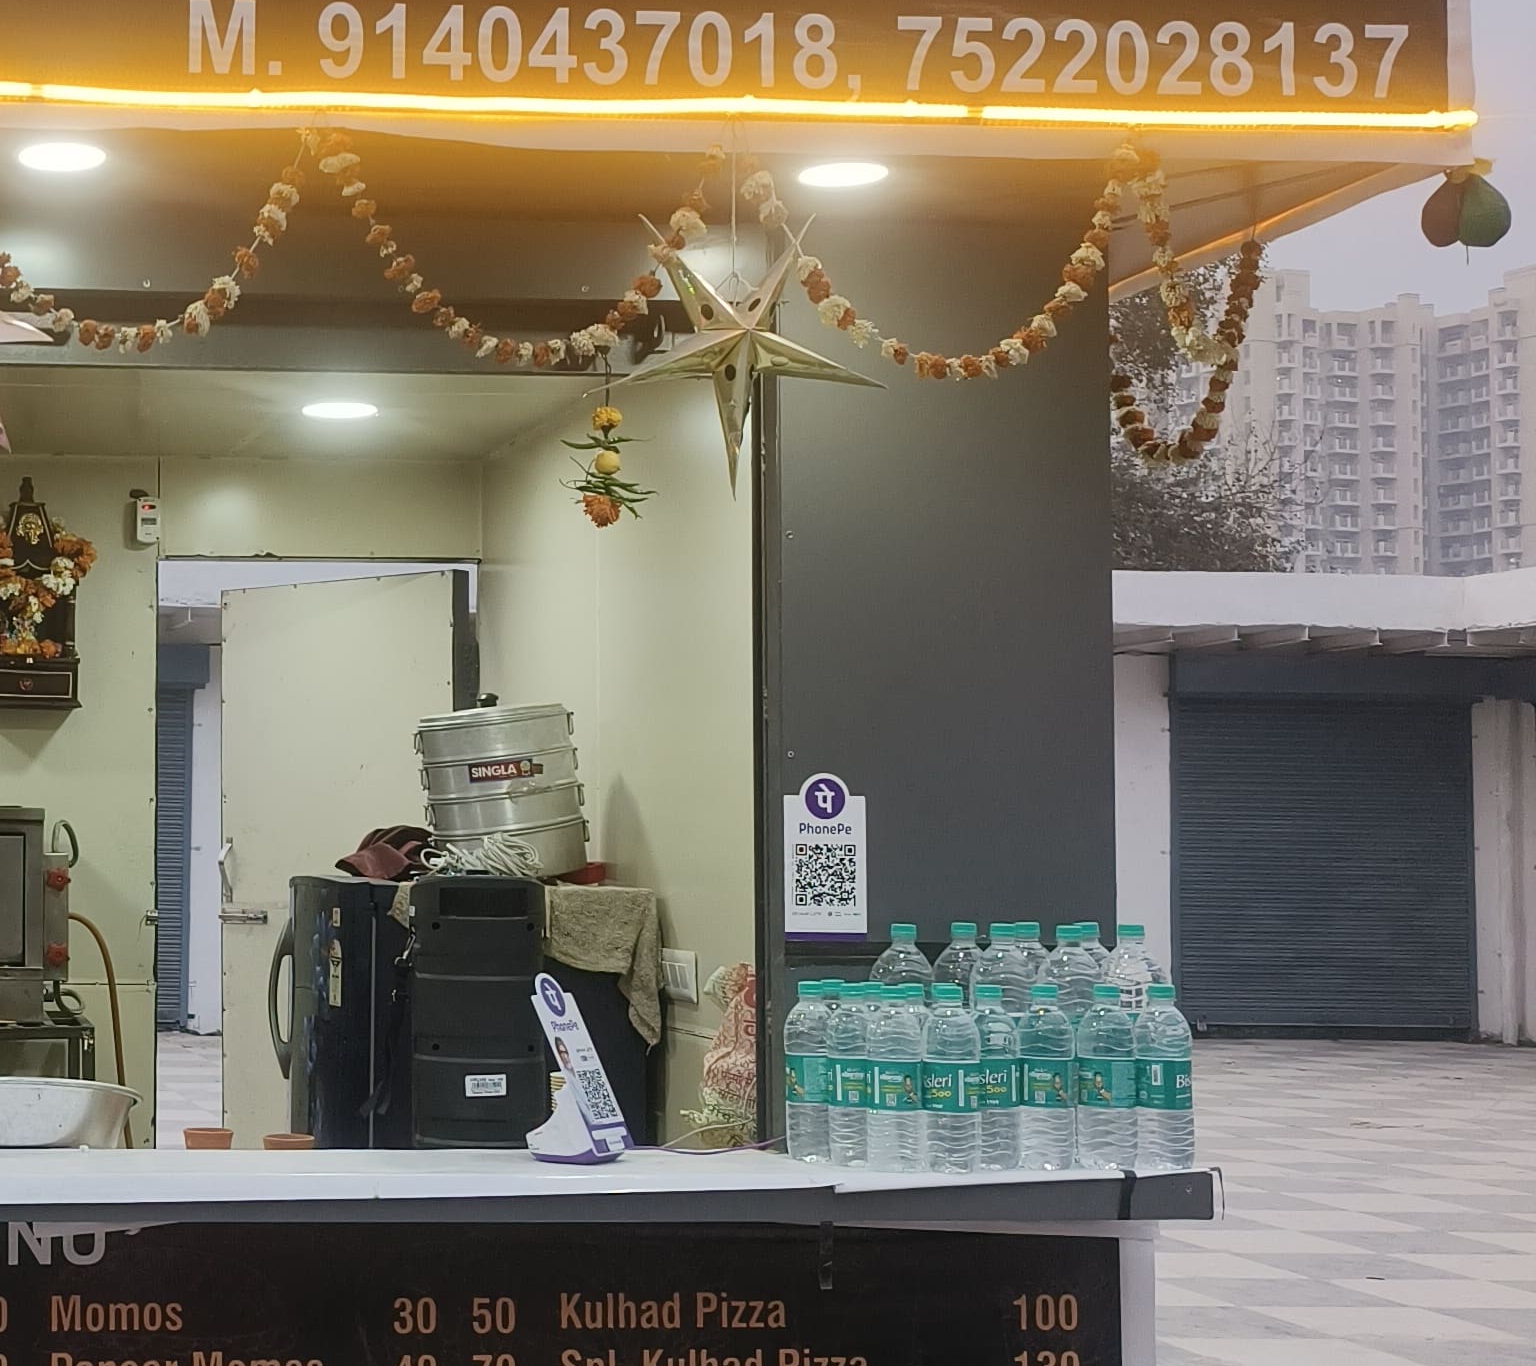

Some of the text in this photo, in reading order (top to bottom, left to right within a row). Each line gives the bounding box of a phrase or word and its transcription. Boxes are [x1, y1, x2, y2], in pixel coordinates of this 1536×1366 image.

[317, 1, 862, 100] 9140437018,
[897, 15, 1409, 99] 7522028137
[470, 763, 518, 779] SINGLA
[799, 822, 852, 835] PhonePe
[924, 1073, 952, 1088] sleri
[979, 1068, 1008, 1085] sleri
[52, 1295, 515, 1333] Momos 30 50
[561, 1293, 1077, 1330] Kulhad Pizza 100
